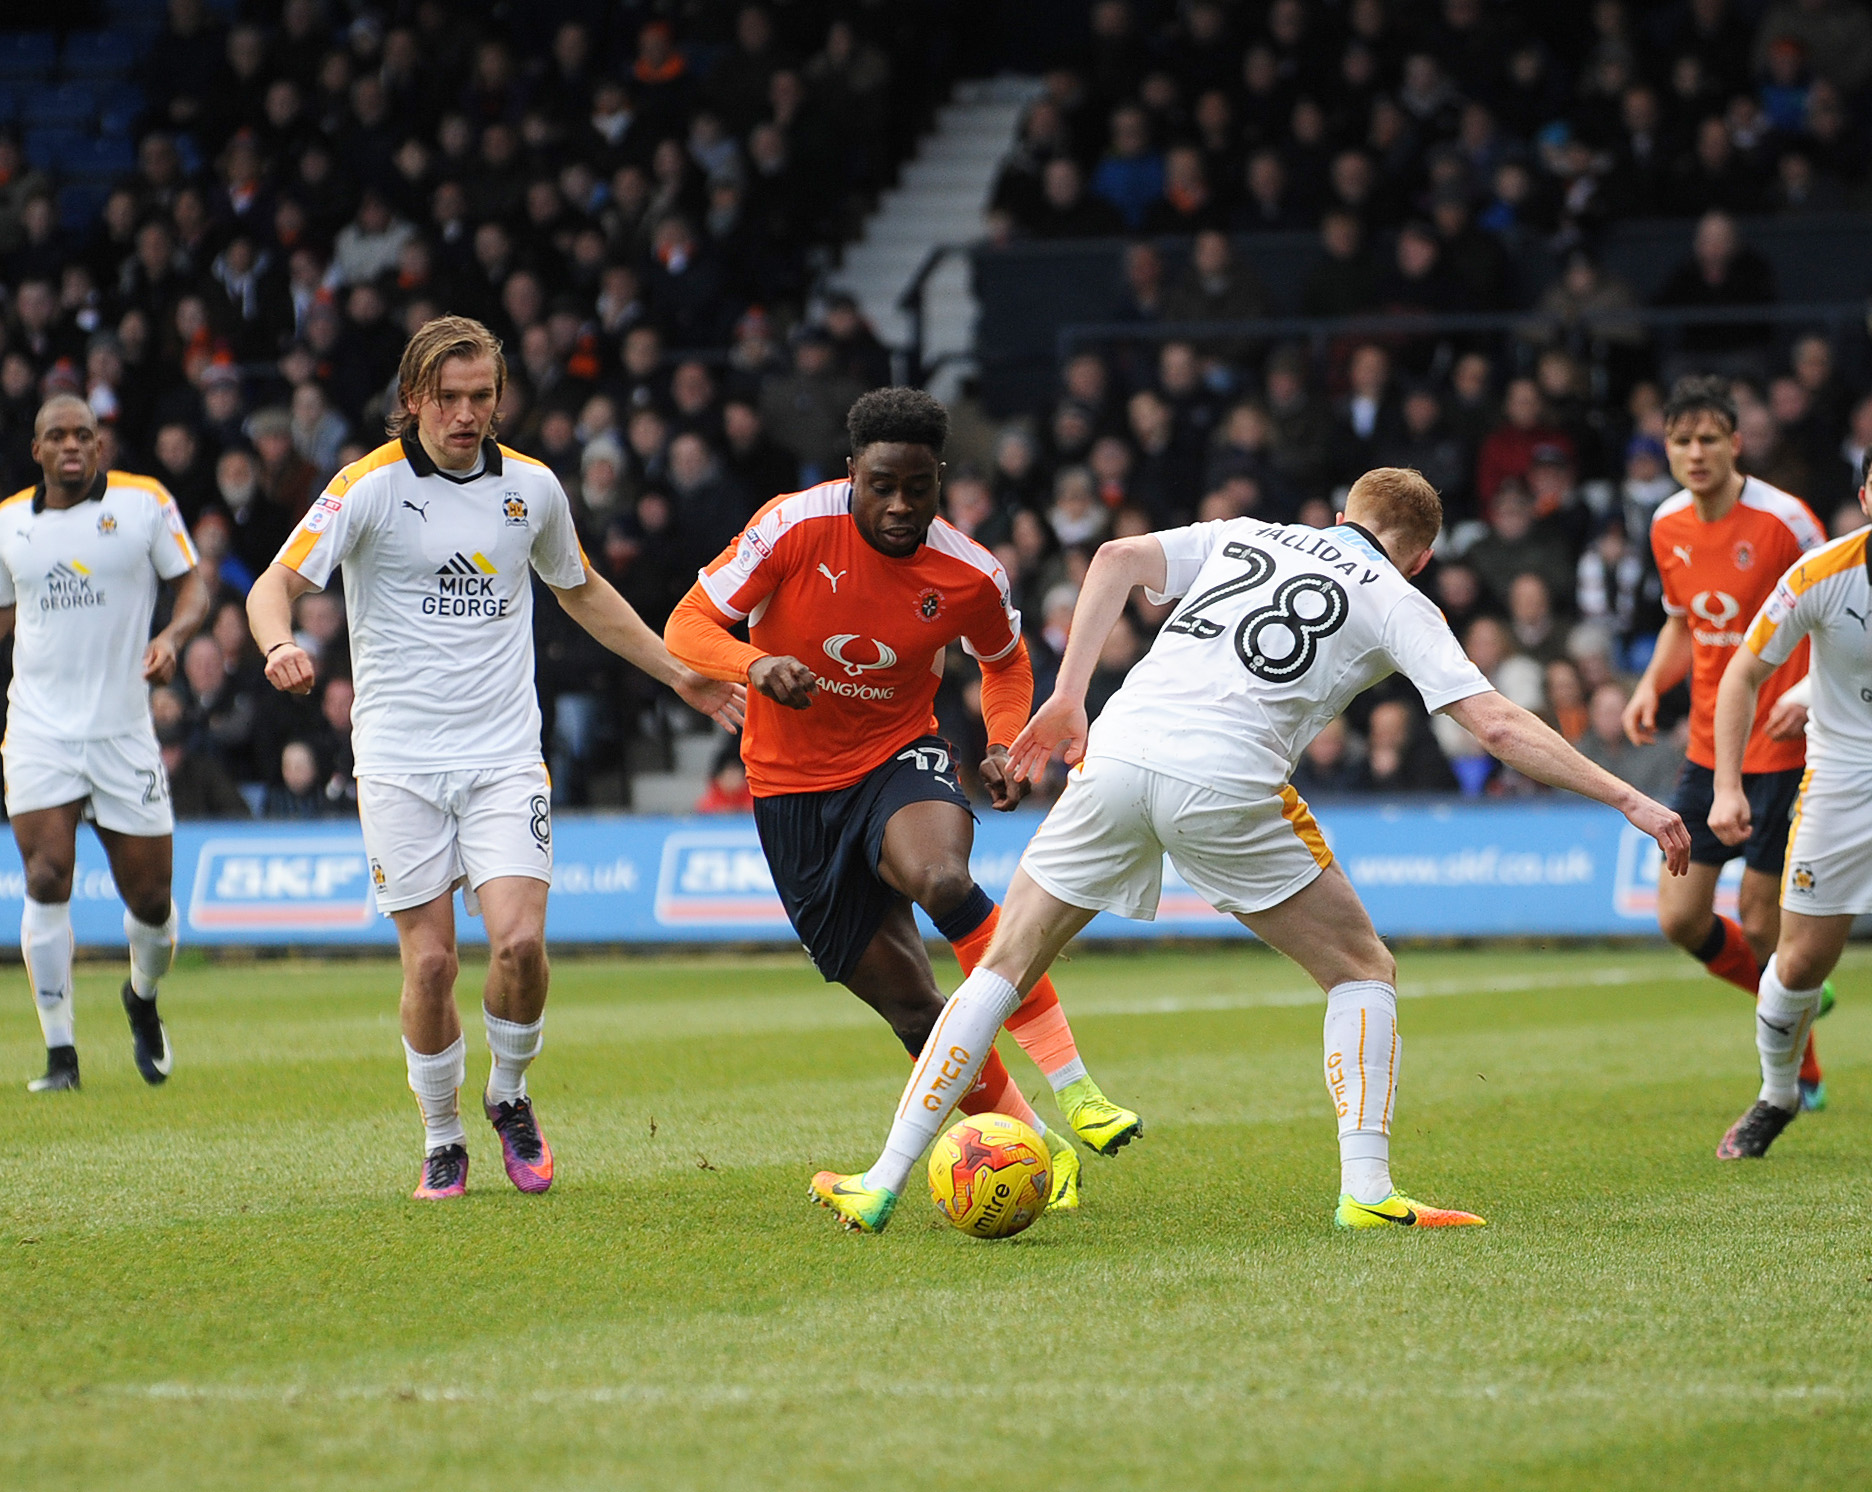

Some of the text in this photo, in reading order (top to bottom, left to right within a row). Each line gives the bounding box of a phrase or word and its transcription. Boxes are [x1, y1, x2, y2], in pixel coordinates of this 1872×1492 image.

[49, 576, 91, 595] MICK
[439, 577, 495, 596] MICK
[41, 591, 106, 612] GEORGE
[422, 597, 509, 617] GEORGE
[1163, 541, 1349, 684] 28
[809, 671, 895, 700] ANGYONG
[529, 794, 551, 845] 8
[922, 1045, 971, 1112] CUFC
[973, 1182, 1011, 1232] mitre
